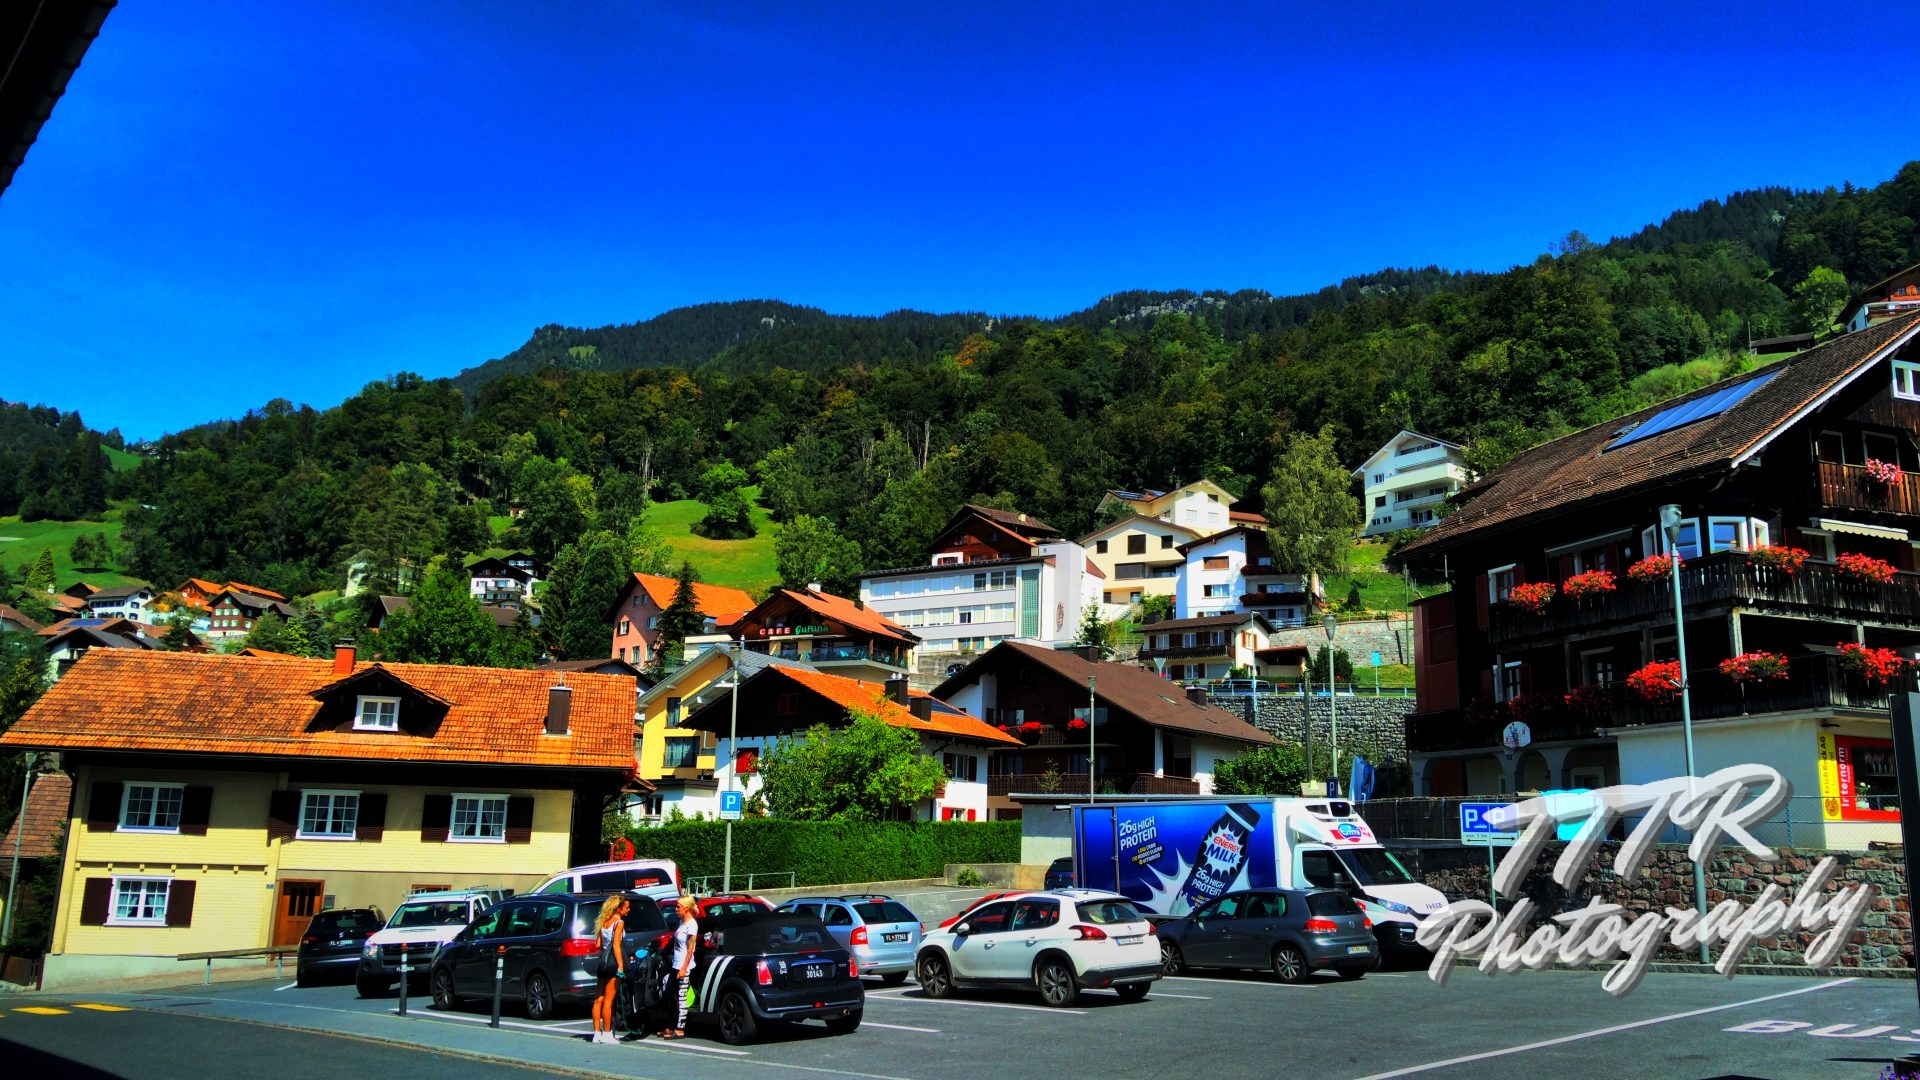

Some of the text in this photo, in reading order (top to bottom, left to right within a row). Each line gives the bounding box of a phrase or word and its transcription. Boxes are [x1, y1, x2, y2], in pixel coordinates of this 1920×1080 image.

[760, 627, 791, 635] CAFE
[1820, 736, 1827, 749] AG
[726, 795, 736, 809] P
[1119, 815, 1155, 837] 26g HIGH
[1465, 809, 1478, 829] P
[1206, 843, 1237, 864] MILK
[1196, 867, 1226, 889] 26g HIGH
